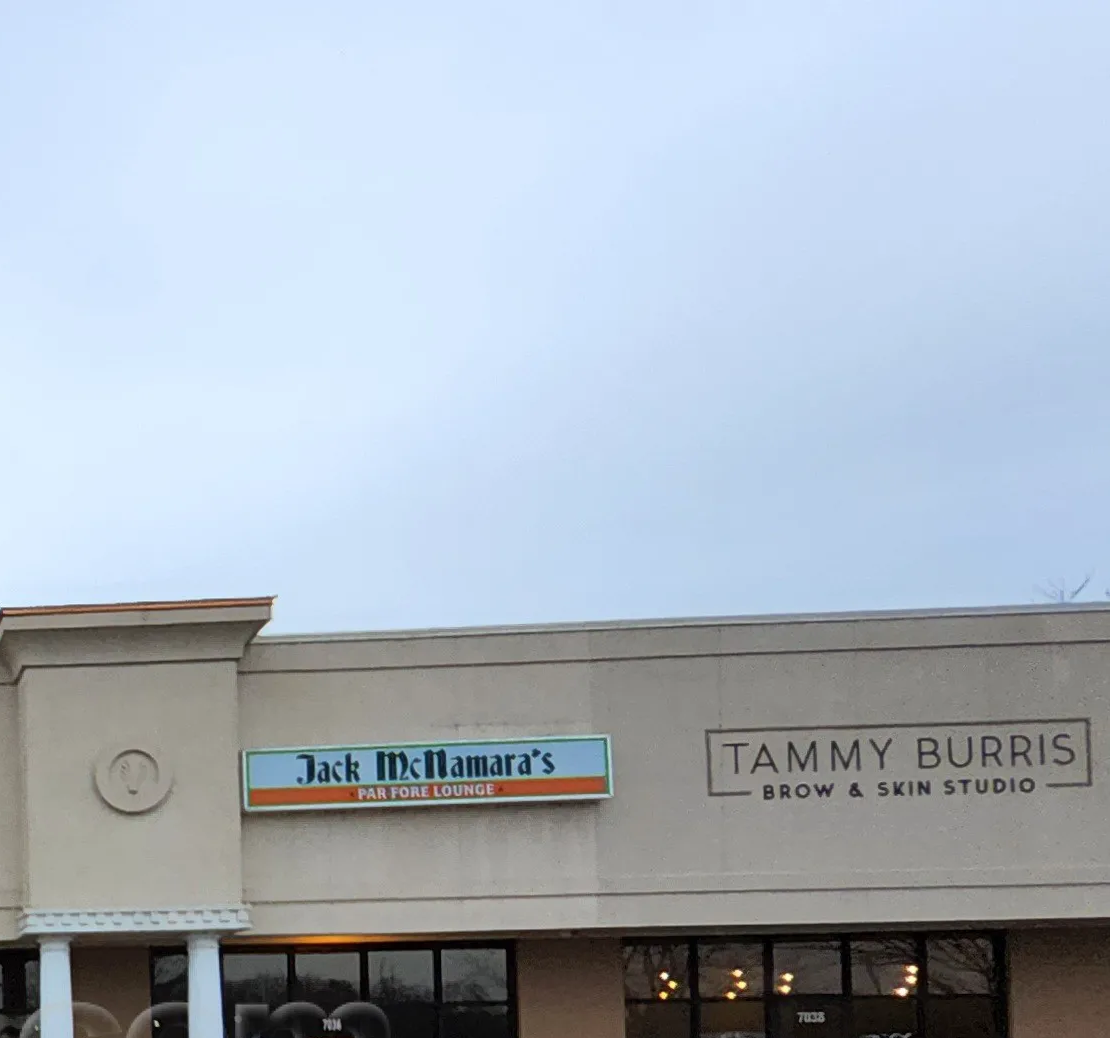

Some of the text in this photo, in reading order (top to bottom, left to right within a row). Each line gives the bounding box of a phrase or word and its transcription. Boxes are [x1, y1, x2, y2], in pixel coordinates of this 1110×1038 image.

[296, 749, 556, 785] Jack McNamara's
[722, 733, 1076, 775] TAMMY BURRIS
[357, 783, 495, 800] PAR FORE LOUNGE
[762, 778, 1036, 800] BROW & SKIN STUDIO
